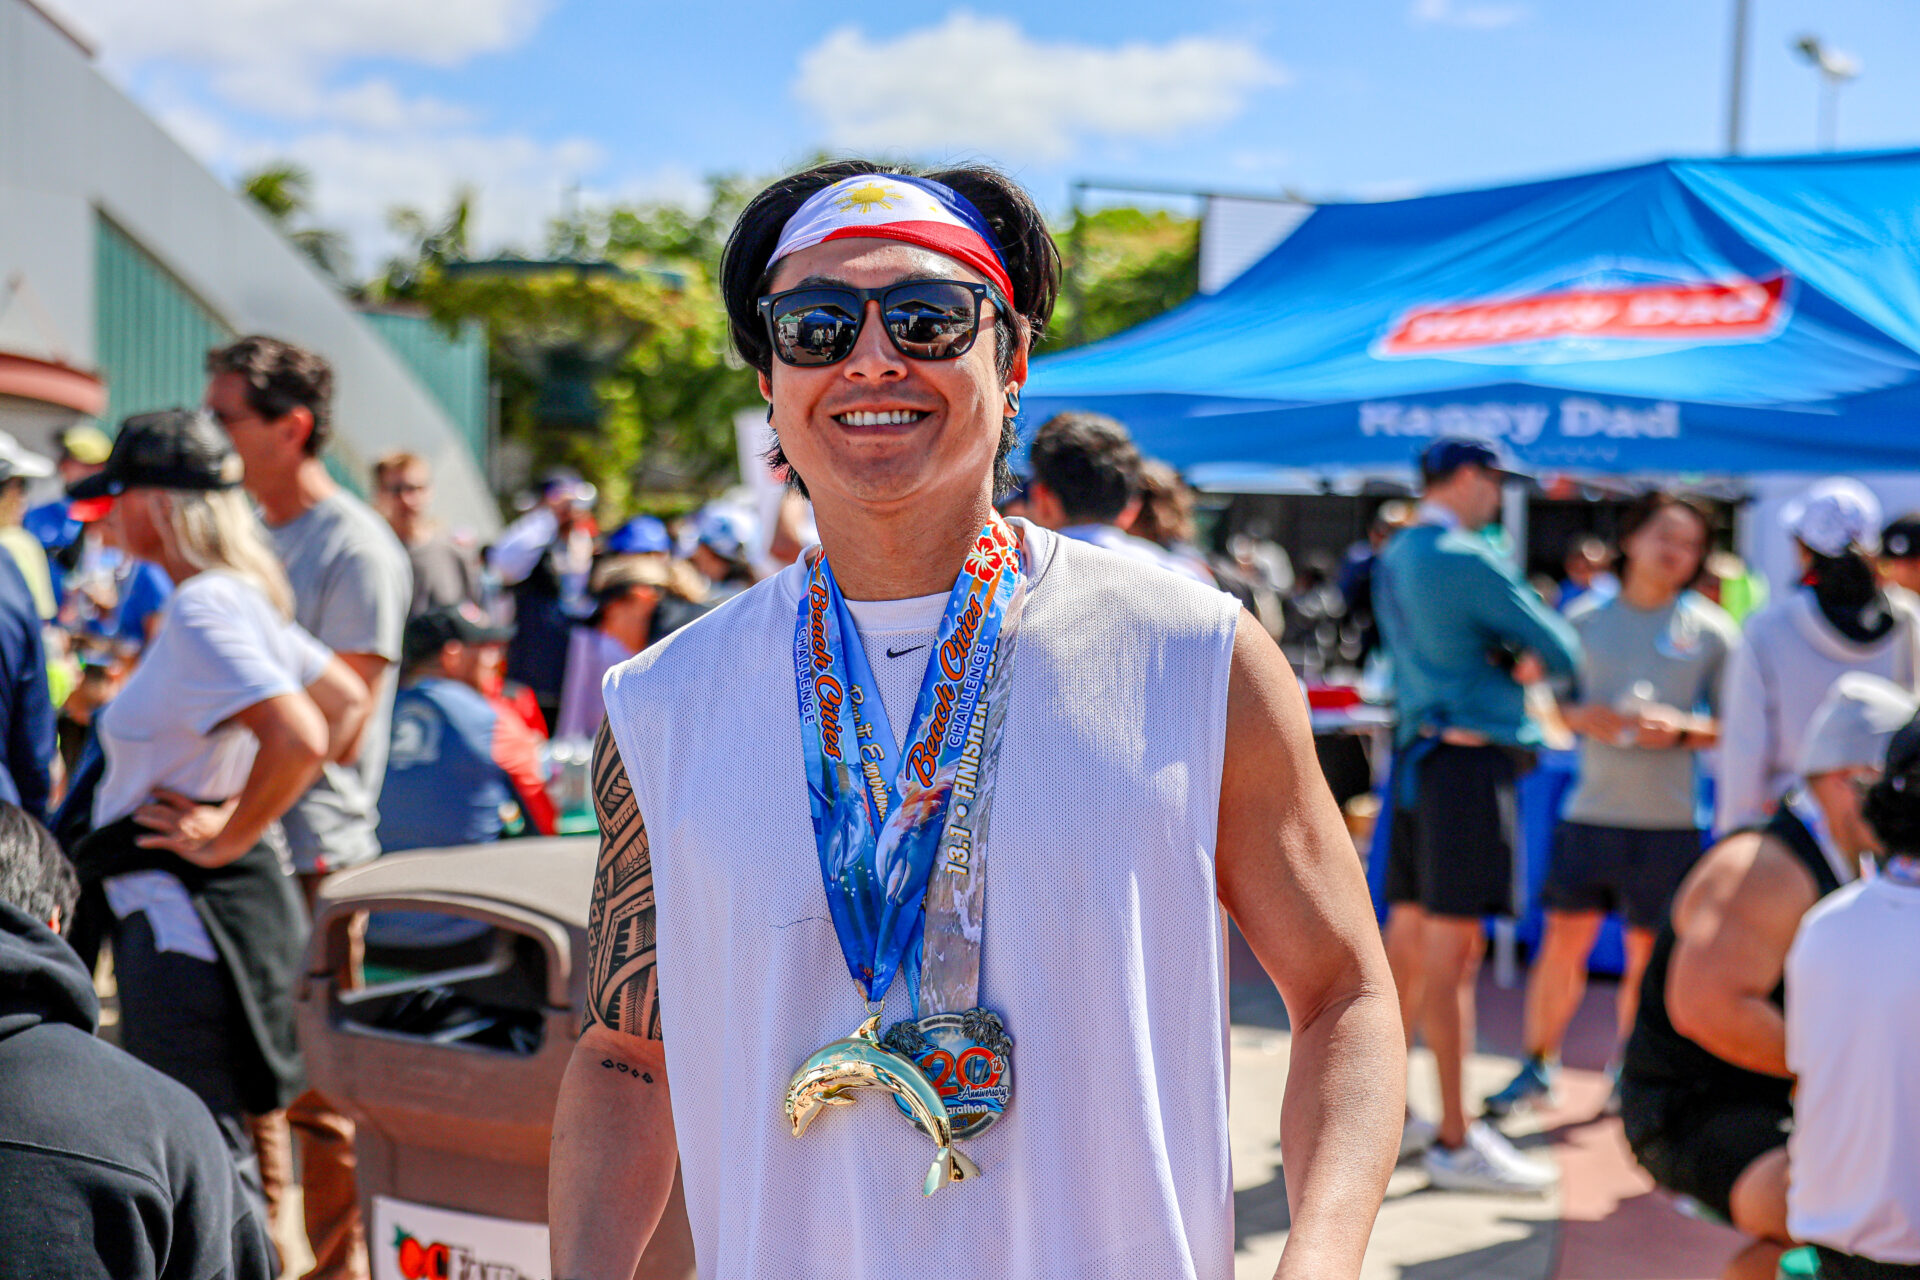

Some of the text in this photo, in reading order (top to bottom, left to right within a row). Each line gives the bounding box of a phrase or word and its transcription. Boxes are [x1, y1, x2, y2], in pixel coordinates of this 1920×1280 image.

[1559, 398, 1681, 438] Dad
[796, 628, 815, 725] CHALLENGE
[809, 575, 844, 761] Beach Cities
[906, 593, 983, 787] Beach Cities
[949, 644, 989, 746] CHALLENGE
[860, 742, 893, 823] Experien
[947, 825, 972, 875] 13.1
[946, 1103, 988, 1115] arathon
[958, 1084, 1009, 1103] Anniversary
